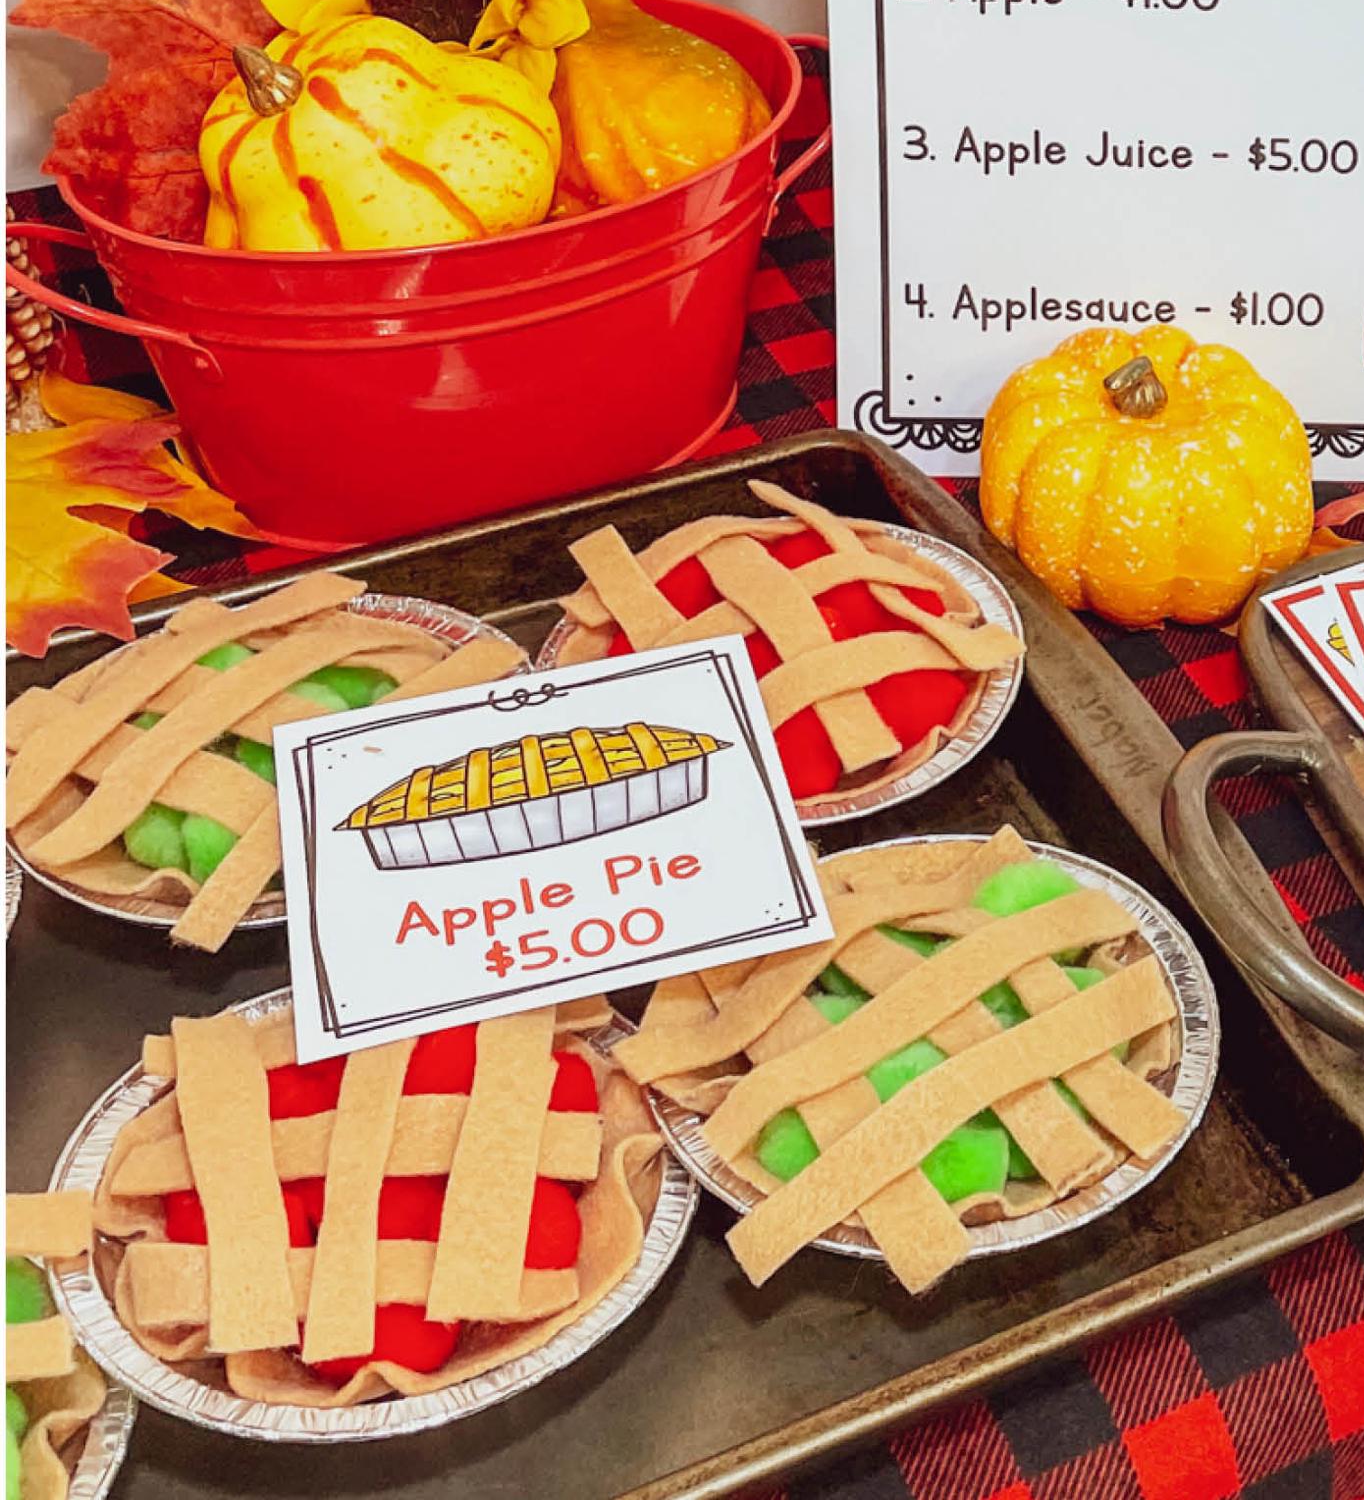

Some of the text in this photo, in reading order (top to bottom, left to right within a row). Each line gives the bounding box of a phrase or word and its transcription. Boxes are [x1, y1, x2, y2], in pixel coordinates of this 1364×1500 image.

[903, 125, 936, 163] 3.
[955, 126, 1067, 176] Apple
[1086, 131, 1193, 170] Juice
[1248, 137, 1359, 175] $5.00
[904, 283, 934, 319] 4.
[952, 284, 1176, 333] Applesauce
[1229, 292, 1324, 329] $1.00
[396, 852, 702, 946] Apple Pie
[485, 906, 664, 977] $5.00
